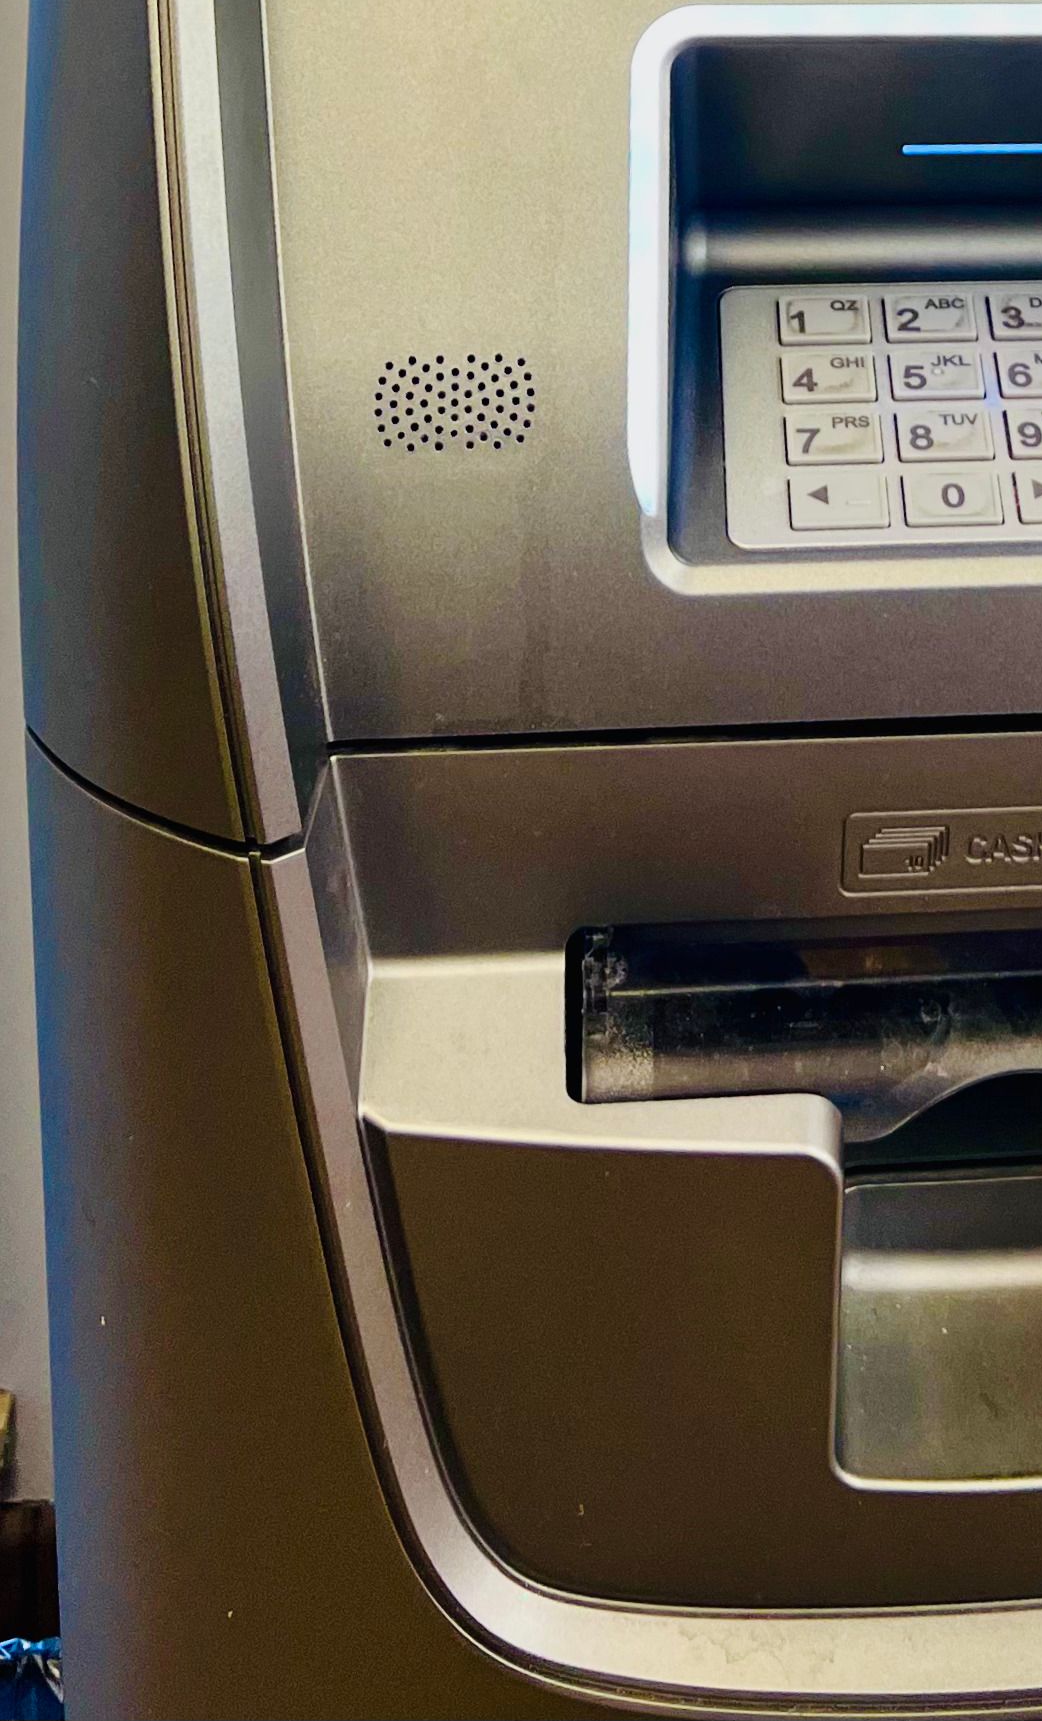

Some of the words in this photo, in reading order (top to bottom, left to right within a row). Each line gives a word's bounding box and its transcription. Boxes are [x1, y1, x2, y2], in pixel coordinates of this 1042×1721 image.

[790, 310, 807, 334] 1
[830, 300, 860, 311] QZ
[896, 308, 921, 332] 2
[924, 297, 966, 310] ABC
[1001, 306, 1025, 329] 3
[792, 368, 818, 392] 4
[830, 357, 865, 368] GHI
[903, 365, 928, 389] 5
[930, 355, 971, 367] JKL
[1007, 363, 1032, 387] 6
[795, 427, 821, 454] 7
[831, 416, 870, 429] PRS
[910, 424, 934, 450] 8
[939, 413, 978, 426] TUV
[1017, 422, 1042, 447] 9
[941, 483, 965, 508] 0
